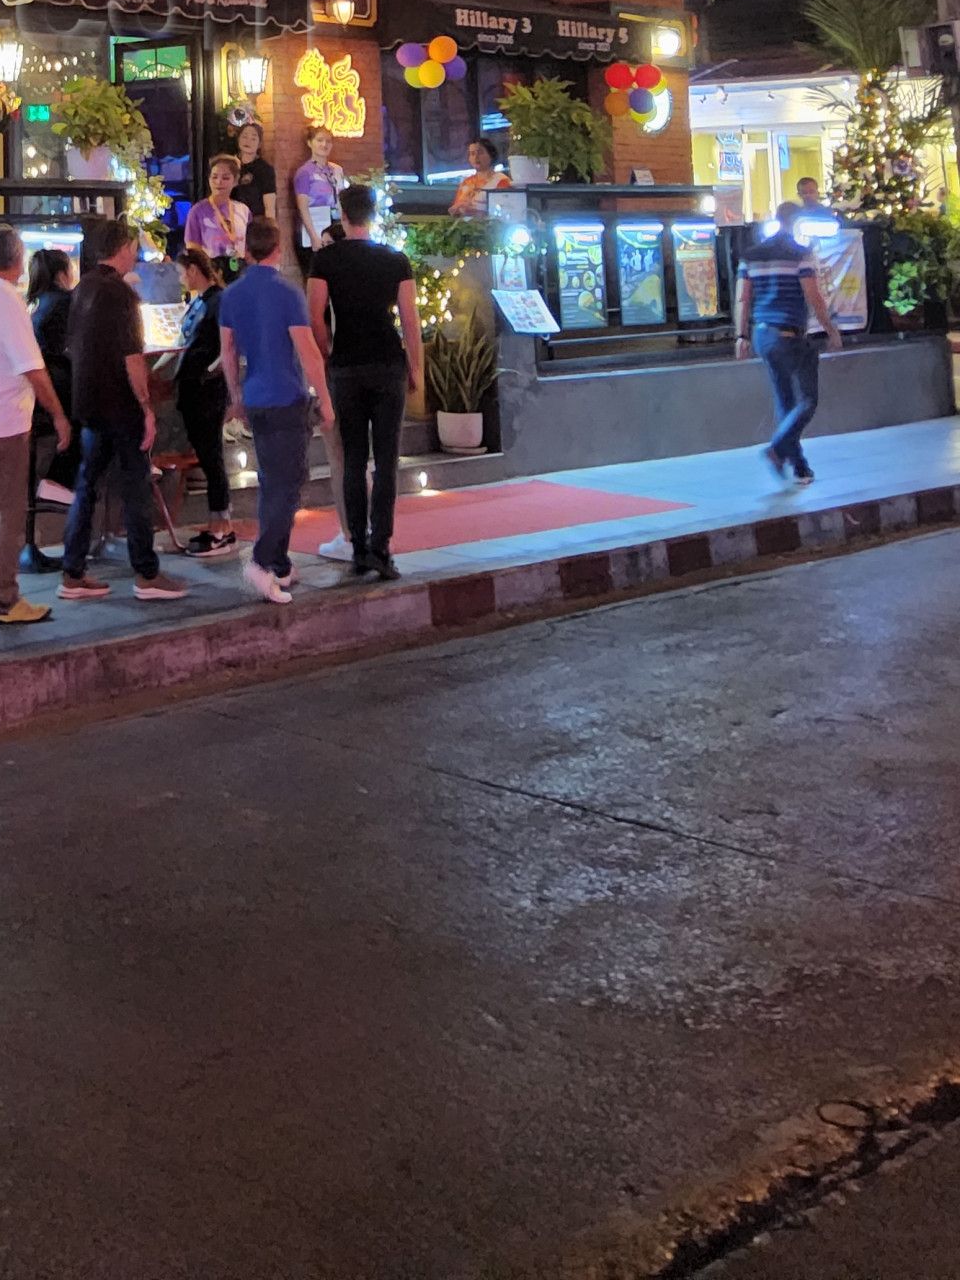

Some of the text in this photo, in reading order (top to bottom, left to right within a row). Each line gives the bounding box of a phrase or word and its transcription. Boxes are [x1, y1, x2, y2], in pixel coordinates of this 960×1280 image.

[456, 8, 532, 34] Hillary 3
[557, 19, 629, 44] Hillary 5
